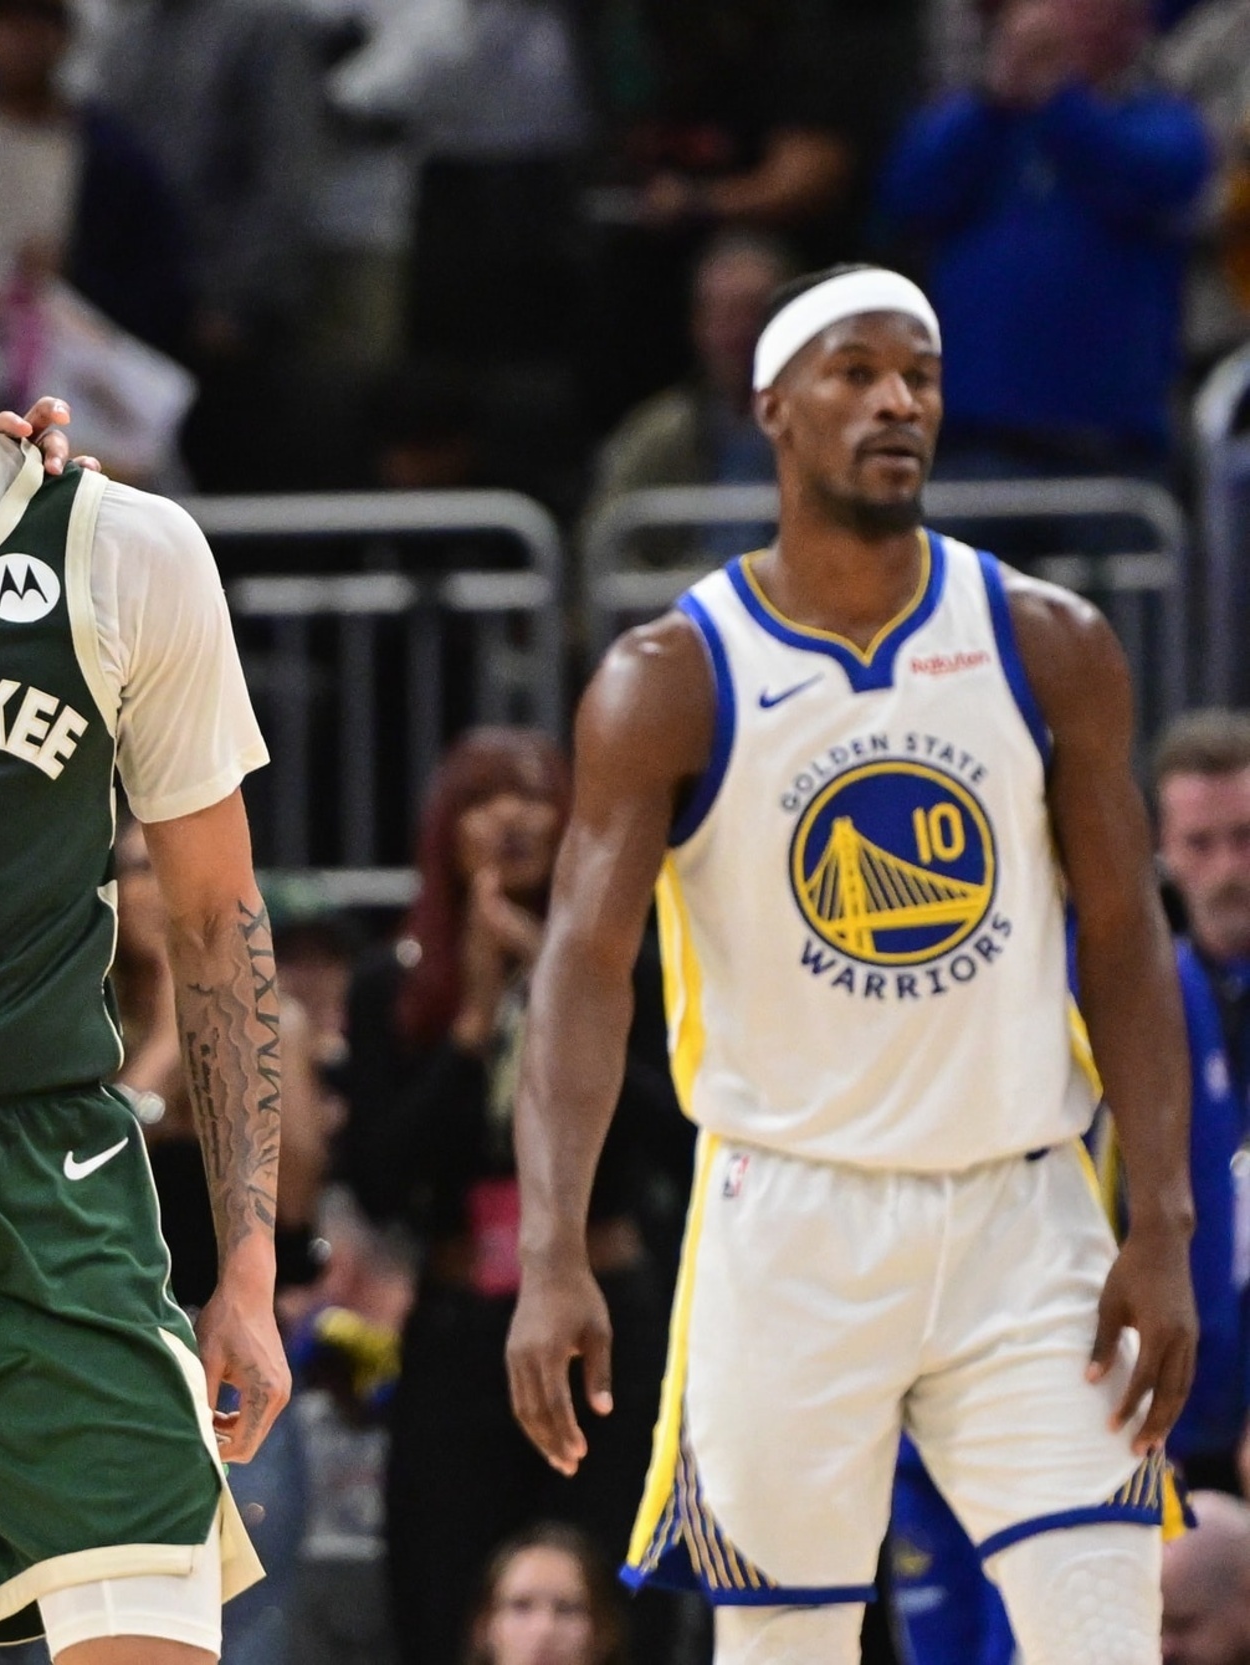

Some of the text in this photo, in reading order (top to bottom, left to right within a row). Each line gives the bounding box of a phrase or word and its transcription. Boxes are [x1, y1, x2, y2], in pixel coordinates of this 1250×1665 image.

[780, 732, 988, 812] GOLDEN STATE
[912, 802, 966, 865] 10
[800, 912, 1013, 1000] WARRIORS
